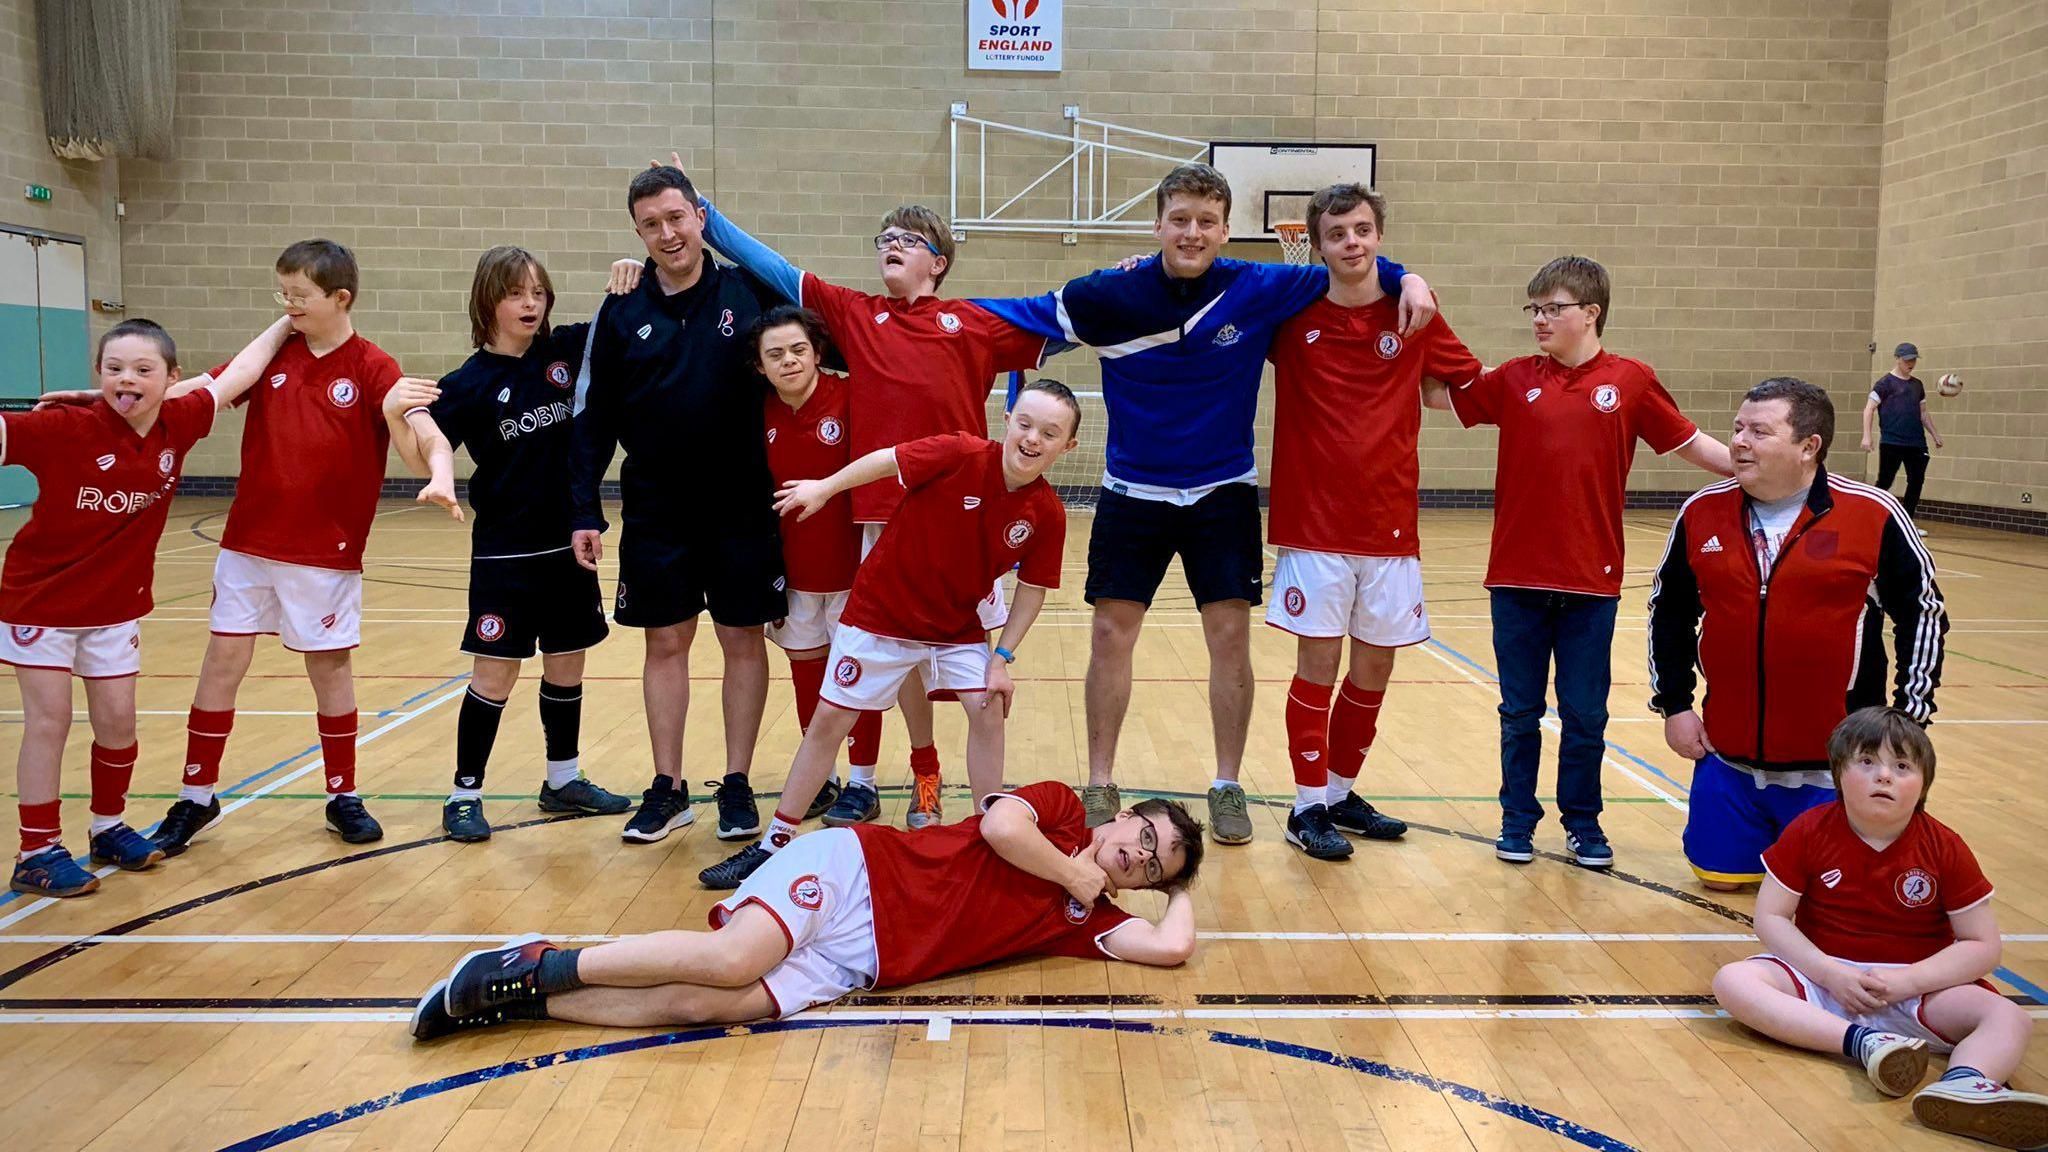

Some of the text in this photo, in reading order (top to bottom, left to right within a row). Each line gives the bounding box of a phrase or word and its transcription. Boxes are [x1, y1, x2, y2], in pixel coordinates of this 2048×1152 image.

[989, 25, 1041, 36] SPORT
[978, 40, 1053, 51] ENGLAND
[499, 397, 576, 440] ROBIN
